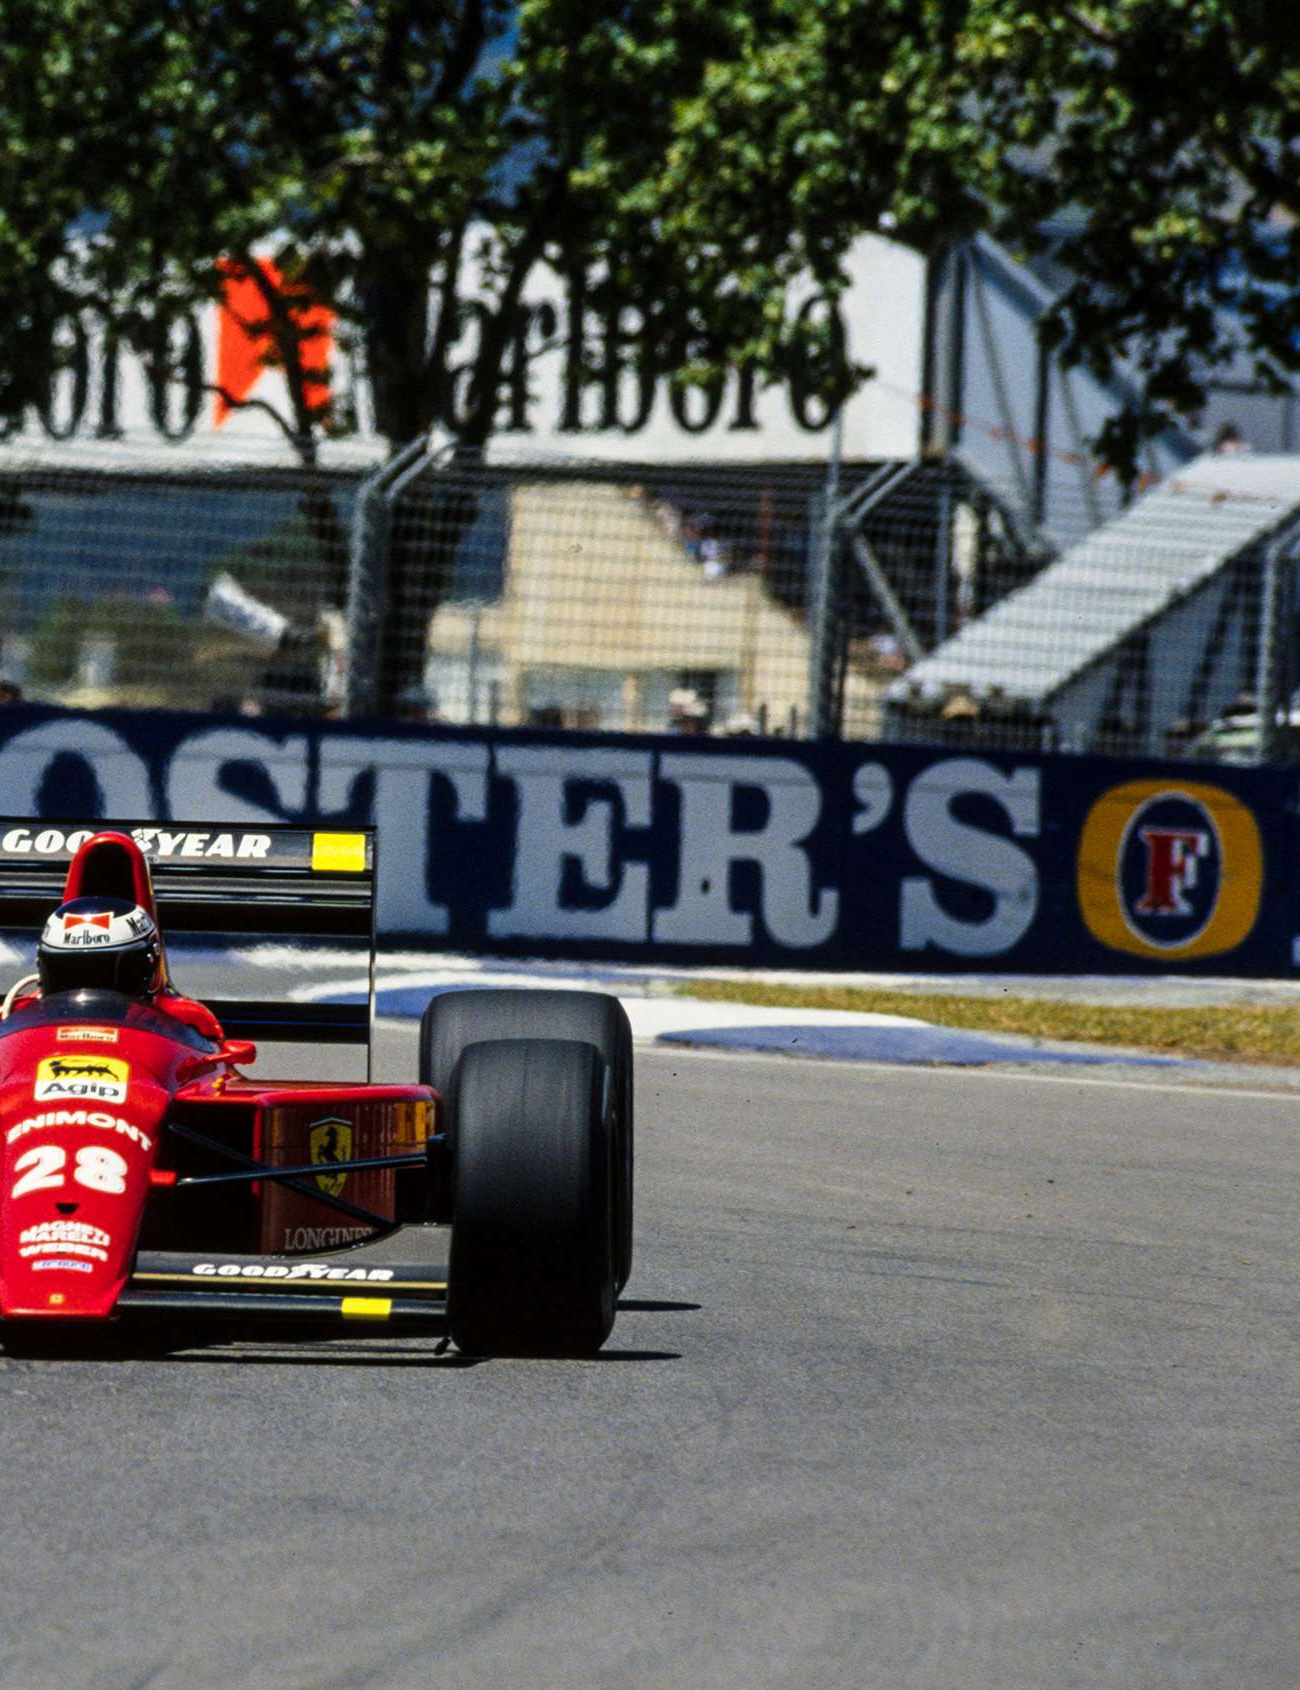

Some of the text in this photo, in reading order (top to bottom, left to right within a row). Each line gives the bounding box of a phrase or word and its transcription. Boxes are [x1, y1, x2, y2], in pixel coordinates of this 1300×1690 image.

[2, 828, 271, 858] GOOYEAR
[1135, 827, 1208, 915] F
[63, 930, 110, 945] Marlboro
[42, 1082, 120, 1097] Agip
[6, 1111, 153, 1151] ENIMONT
[11, 1145, 129, 1199] 28
[192, 1264, 394, 1281] GOODYEAR
